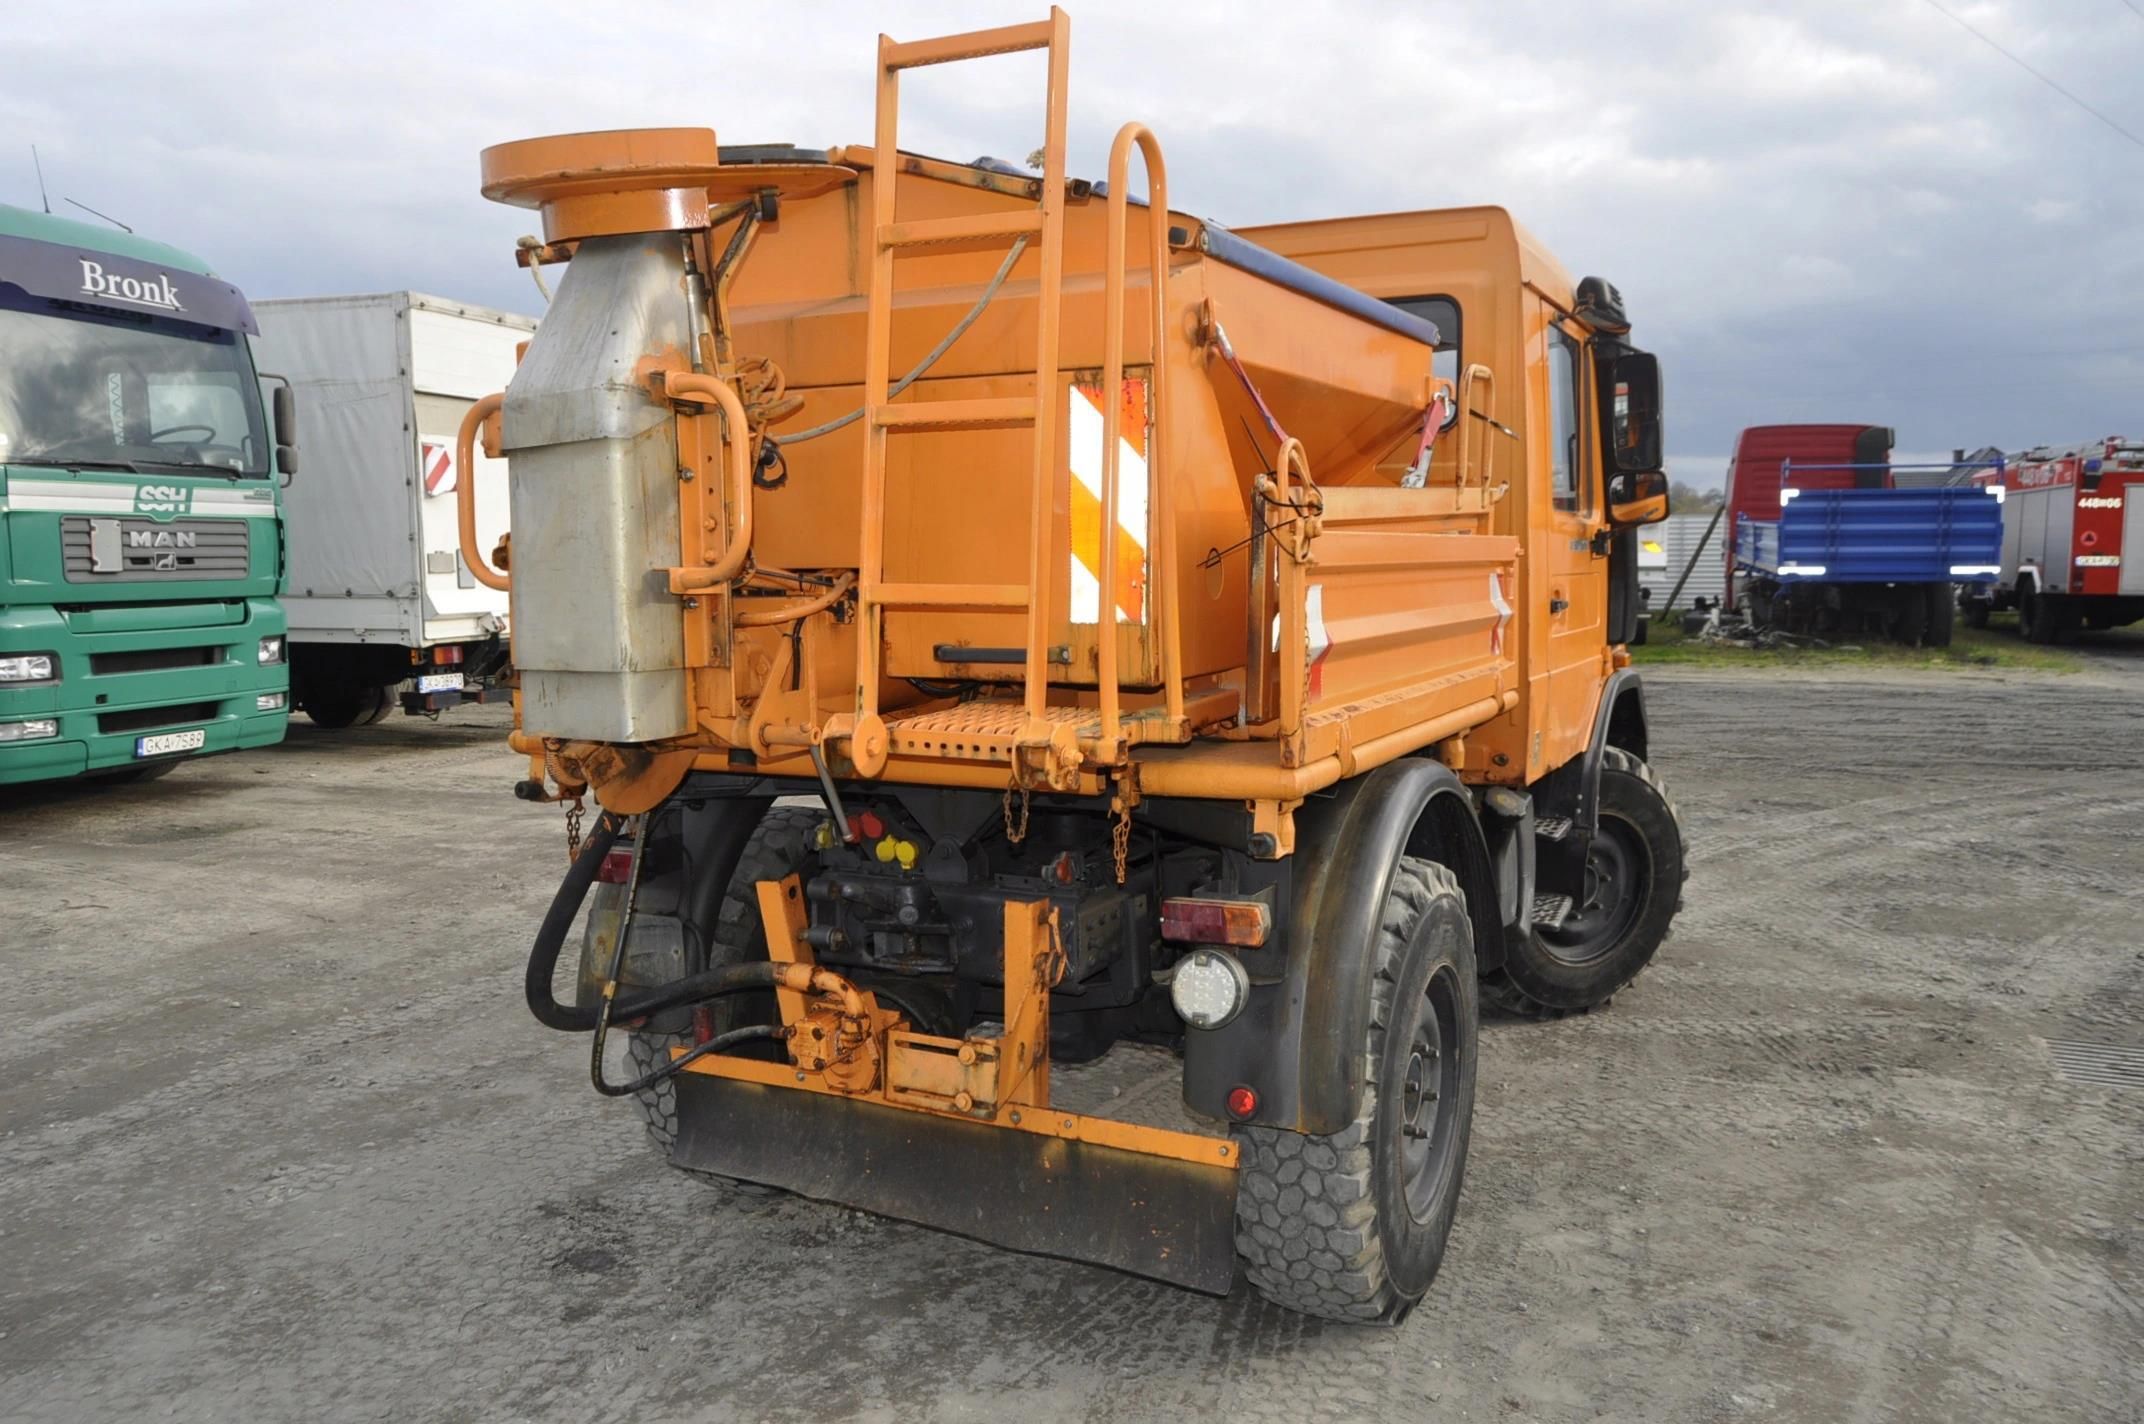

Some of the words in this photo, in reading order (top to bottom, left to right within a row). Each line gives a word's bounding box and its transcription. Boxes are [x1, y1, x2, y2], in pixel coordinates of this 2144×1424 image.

[79, 259, 183, 308] Bronk
[138, 485, 186, 512] SSH
[130, 531, 196, 547] MAN
[146, 737, 170, 753] GKA
